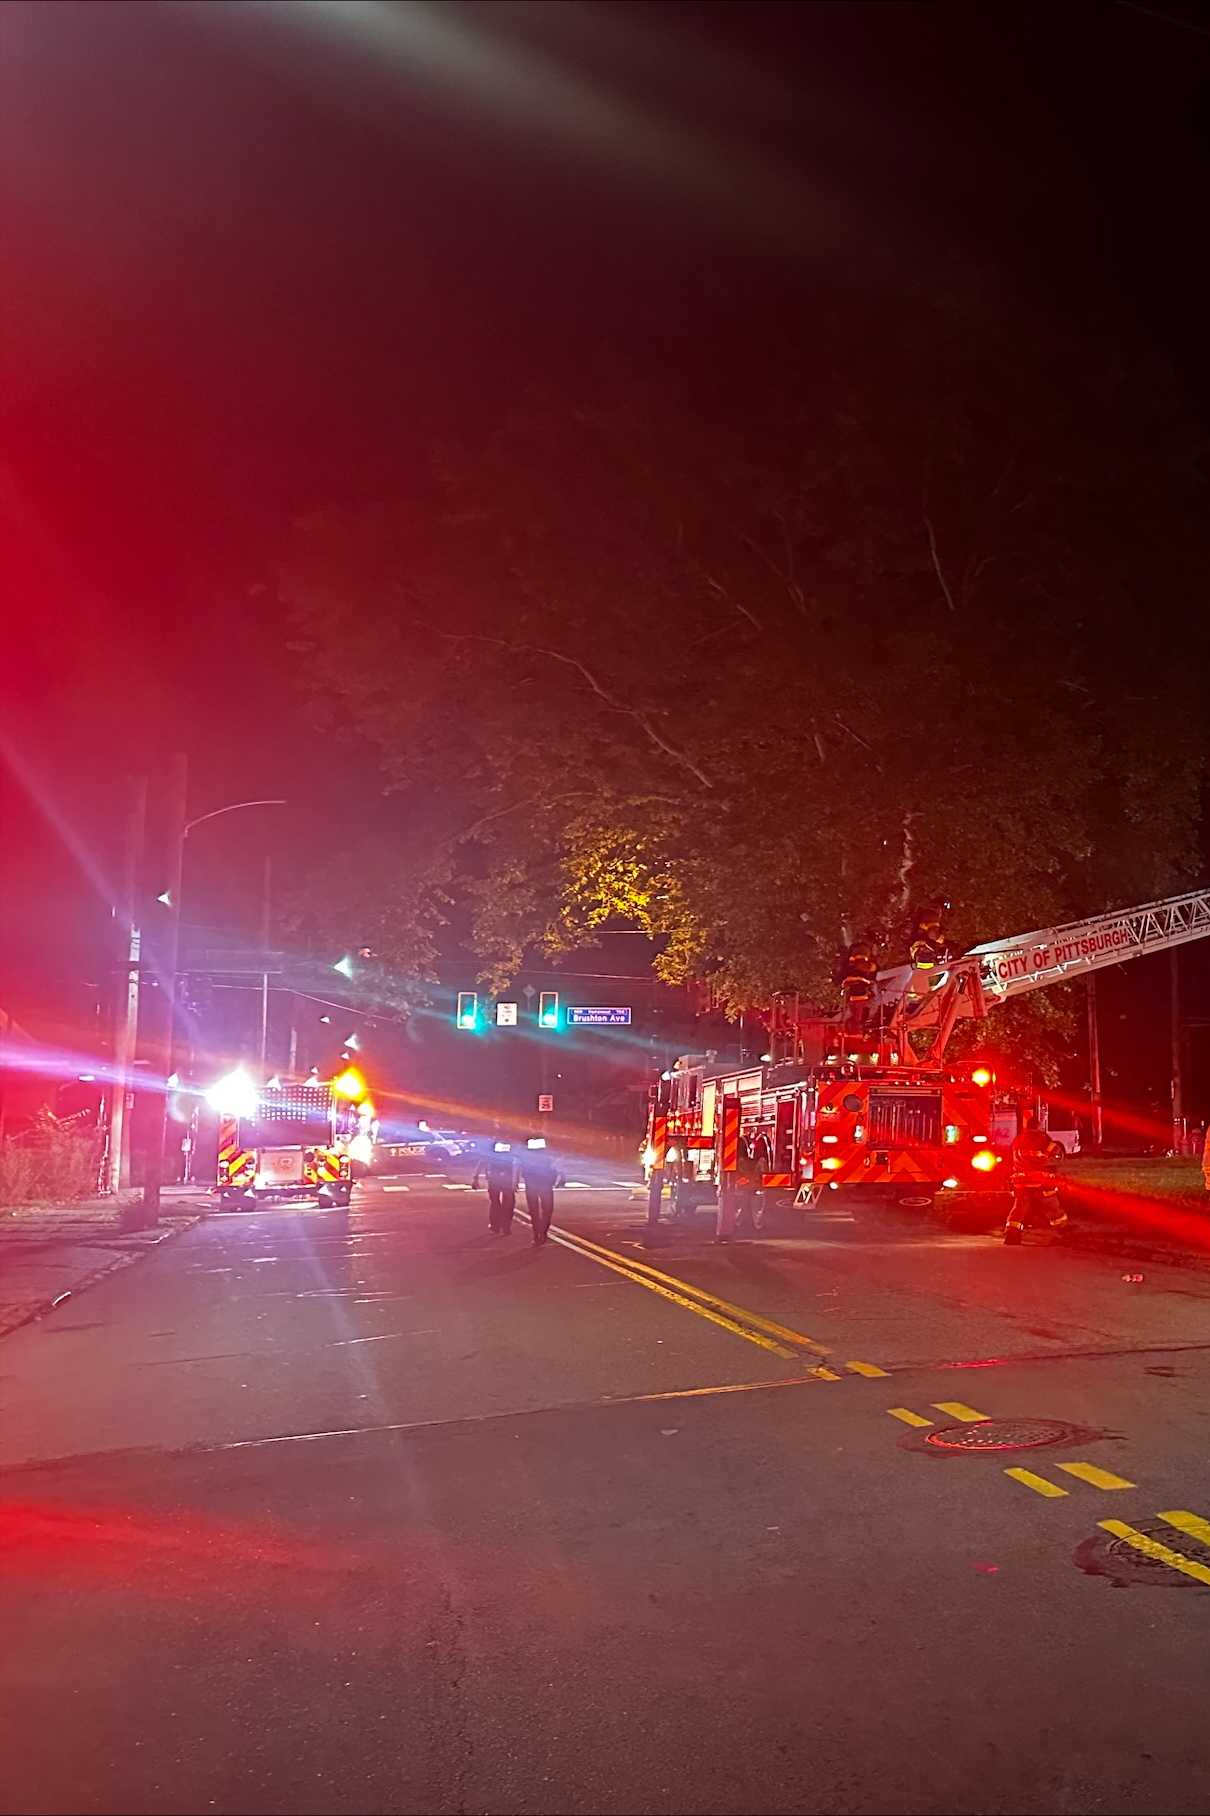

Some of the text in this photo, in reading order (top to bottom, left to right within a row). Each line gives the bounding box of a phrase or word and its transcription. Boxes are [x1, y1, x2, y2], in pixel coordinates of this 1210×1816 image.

[997, 928, 1128, 979] CITY OF PITTSBURGH
[573, 1014, 626, 1022] Brushton Ave
